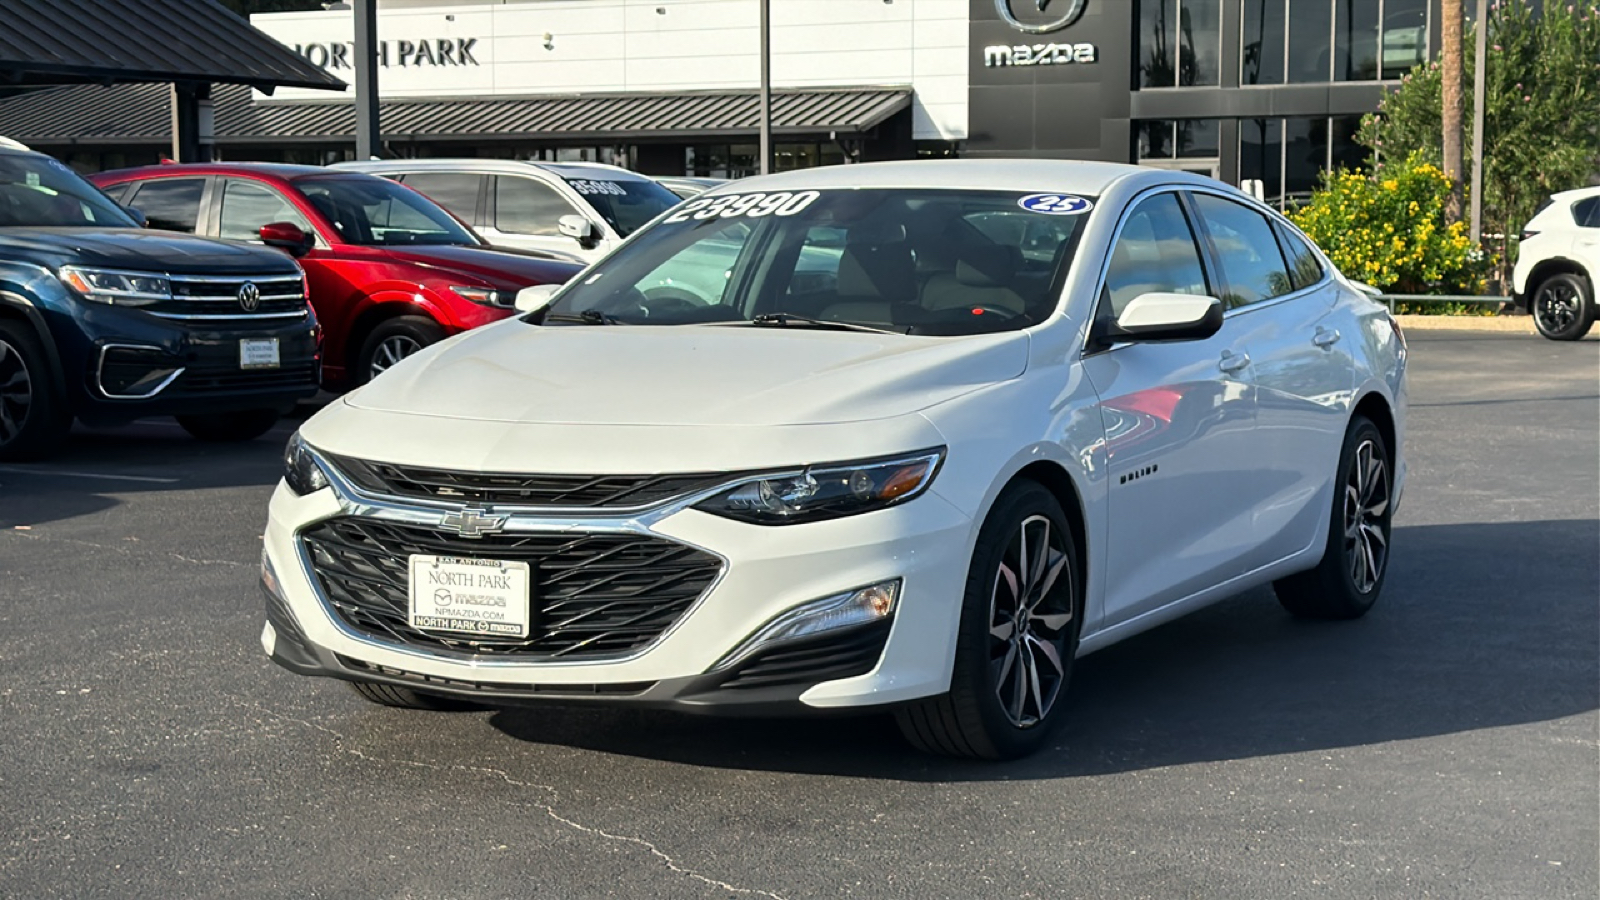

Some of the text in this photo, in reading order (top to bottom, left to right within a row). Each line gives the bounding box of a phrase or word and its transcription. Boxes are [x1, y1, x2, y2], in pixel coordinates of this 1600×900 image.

[397, 37, 480, 66] PARK
[984, 43, 1095, 67] mazda
[662, 190, 821, 225] 23990
[1031, 196, 1080, 212] 25
[429, 570, 511, 590] NORTH PARK
[416, 616, 449, 629] NORTH
[451, 619, 477, 631] PARK
[435, 607, 505, 620] NPMAZDA.COM
